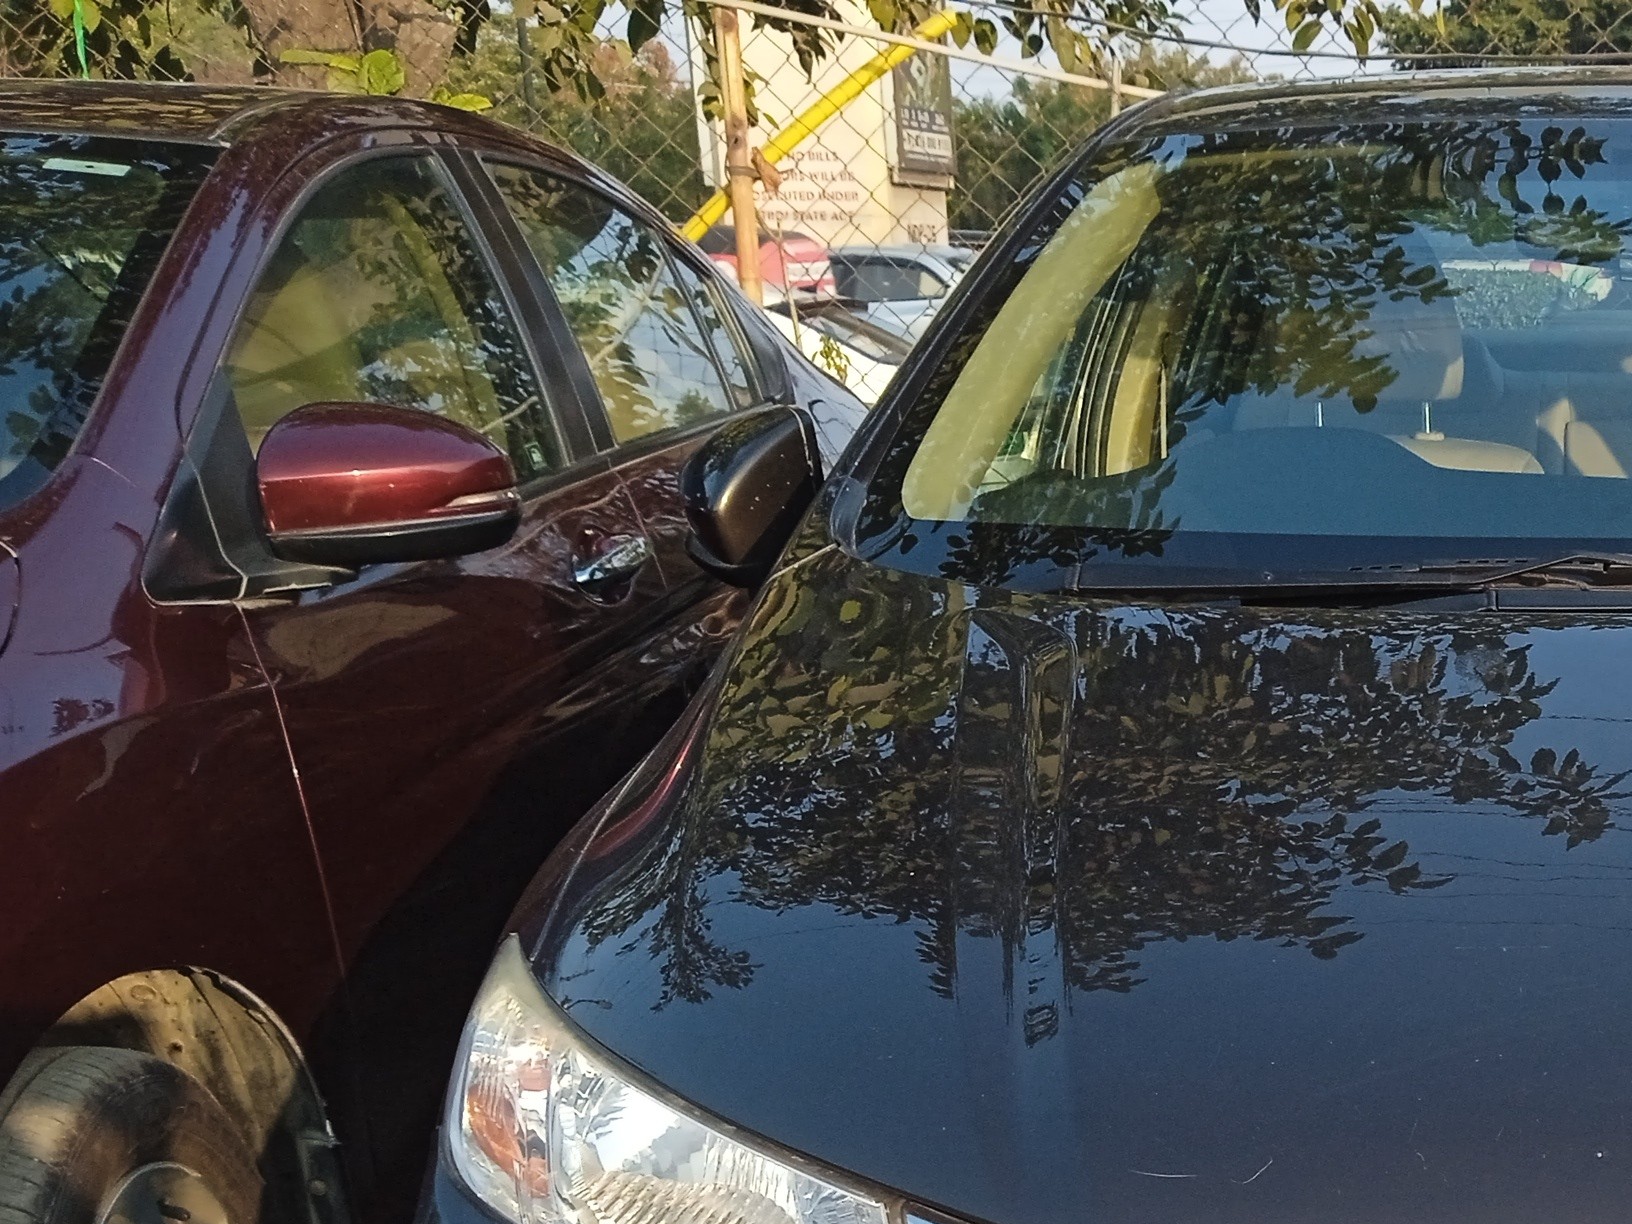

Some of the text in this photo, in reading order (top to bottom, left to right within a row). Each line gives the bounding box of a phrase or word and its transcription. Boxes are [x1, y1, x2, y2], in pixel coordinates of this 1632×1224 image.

[807, 150, 839, 161] BILLS
[810, 171, 836, 182] WILL
[840, 171, 855, 182] BE
[819, 190, 859, 201] UNDER
[793, 210, 827, 221] STATE
[830, 210, 855, 221] ACT
